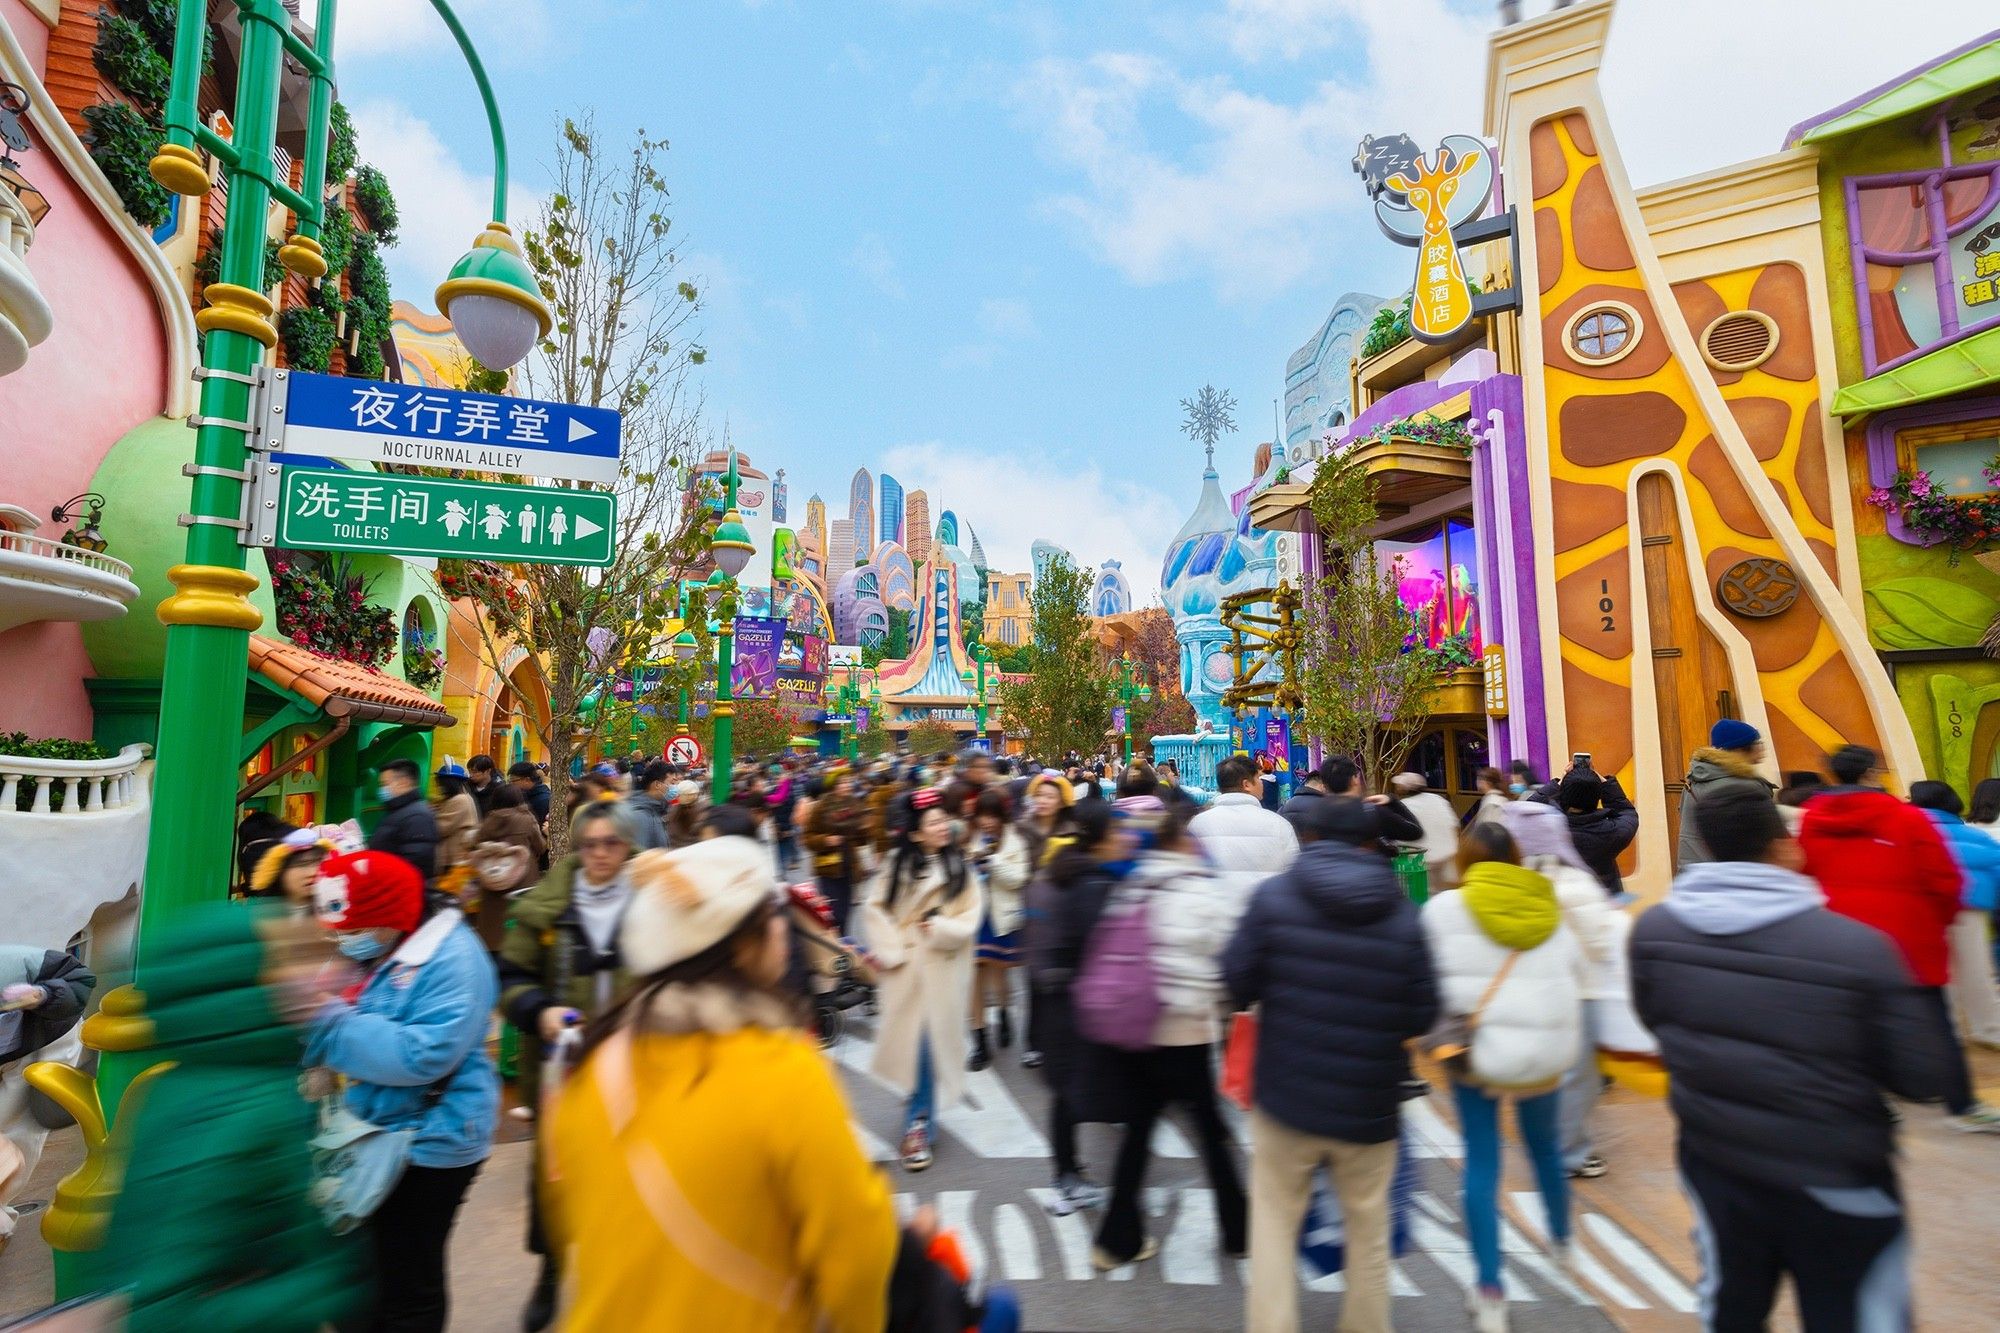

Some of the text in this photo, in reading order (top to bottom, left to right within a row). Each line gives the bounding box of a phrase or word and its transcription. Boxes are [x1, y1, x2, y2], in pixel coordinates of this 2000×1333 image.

[1427, 244, 1450, 324] 胶囊酒店
[1963, 277, 2000, 306] 租
[349, 386, 550, 445] 夜行弄堂
[382, 441, 523, 469] NOCTURNAL ALLEY
[295, 480, 429, 526] 洗手间
[333, 523, 389, 541] TOILETS
[1599, 579, 1616, 632] 102
[738, 634, 773, 642] GAZELLE
[776, 677, 817, 693] GAZELLE
[931, 708, 953, 719] CITY
[1949, 700, 1962, 738] 108
